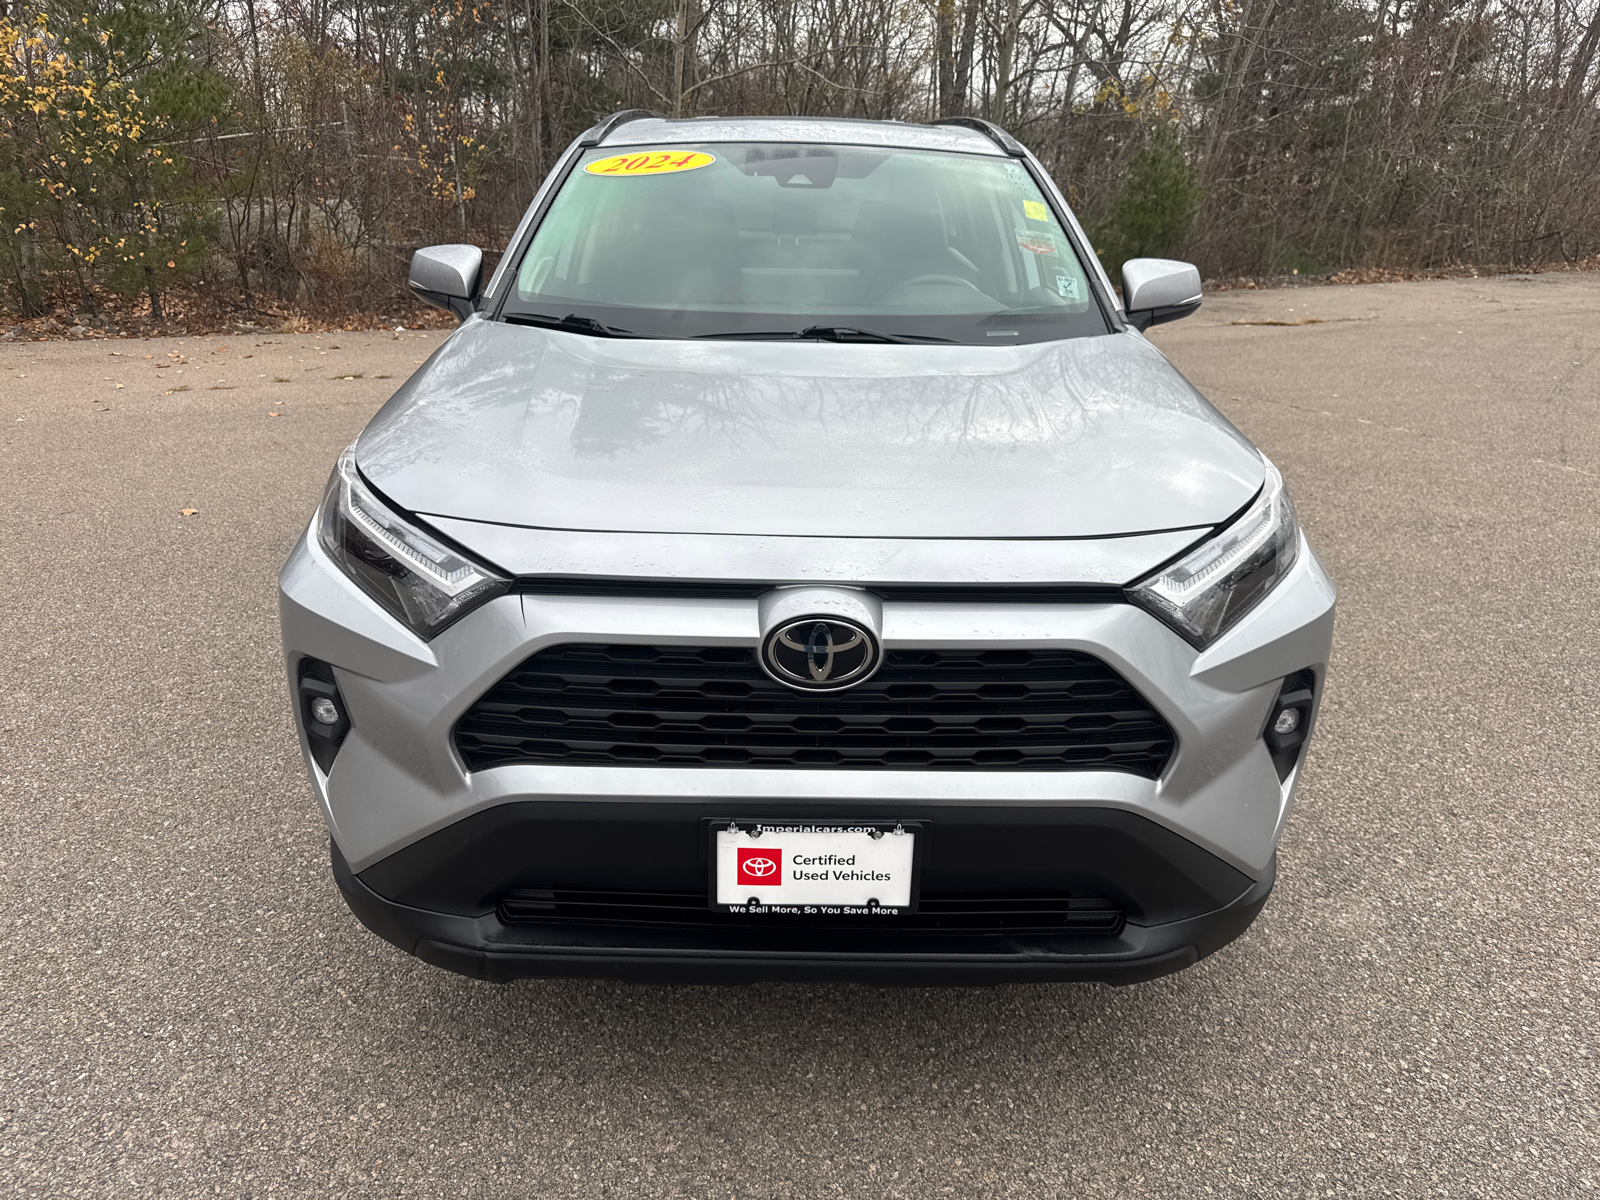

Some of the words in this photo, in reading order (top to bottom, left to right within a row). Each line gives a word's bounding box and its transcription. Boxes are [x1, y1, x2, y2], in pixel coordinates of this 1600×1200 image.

[601, 154, 697, 173] 2024
[756, 824, 876, 833] Imperialcars.com
[792, 854, 856, 866] Certified
[793, 870, 829, 881] Used
[832, 870, 891, 881] Vehicles
[729, 905, 746, 913] We
[749, 905, 768, 914] Sell
[771, 906, 801, 915] More,
[804, 906, 818, 914] So
[821, 906, 841, 914] You
[843, 906, 869, 915] Save
[871, 907, 898, 915] More
